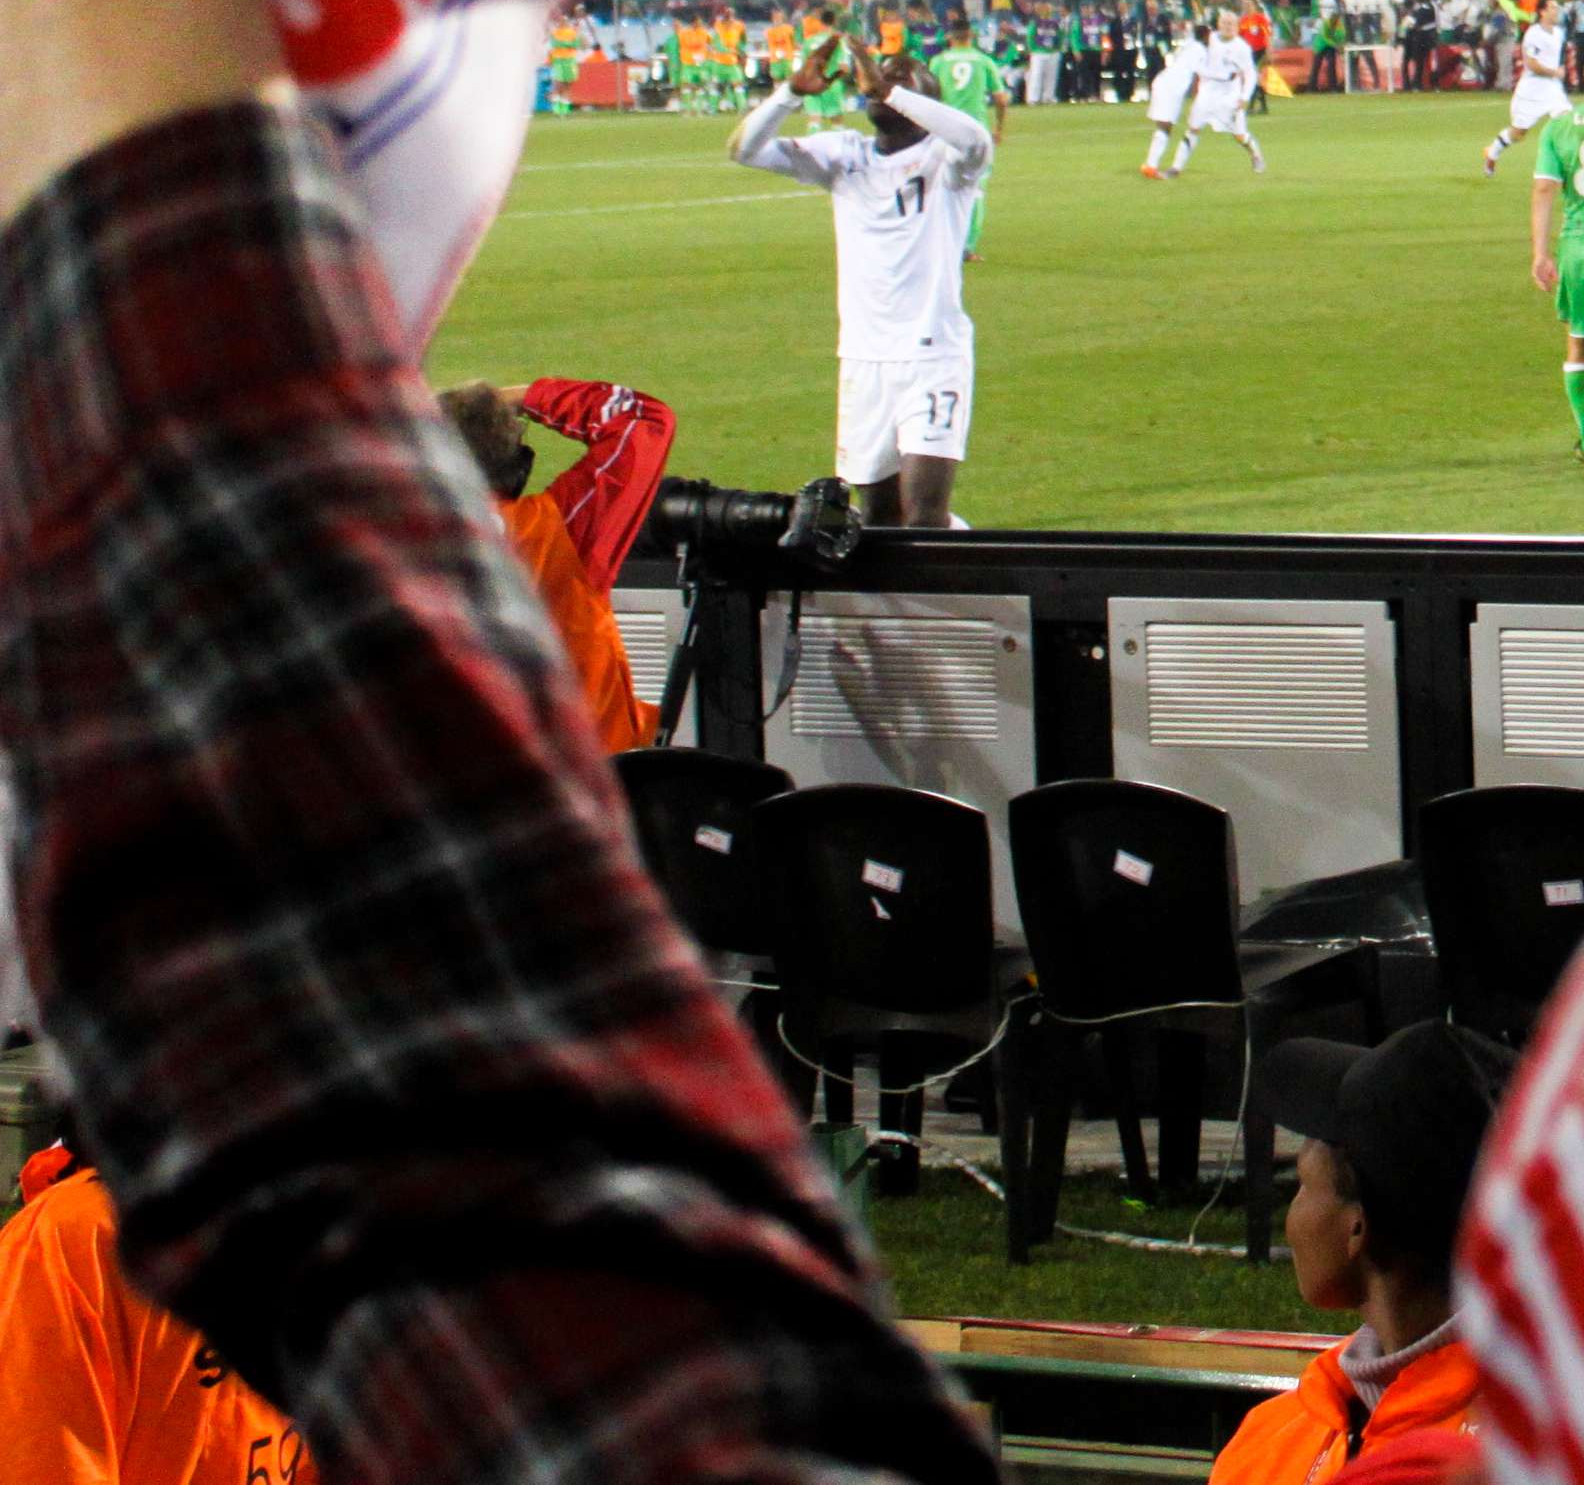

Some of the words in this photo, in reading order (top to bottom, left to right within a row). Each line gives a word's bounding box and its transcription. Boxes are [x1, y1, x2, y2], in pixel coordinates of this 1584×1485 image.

[951, 61, 973, 91] 9
[896, 175, 926, 217] 17
[926, 390, 960, 429] 17
